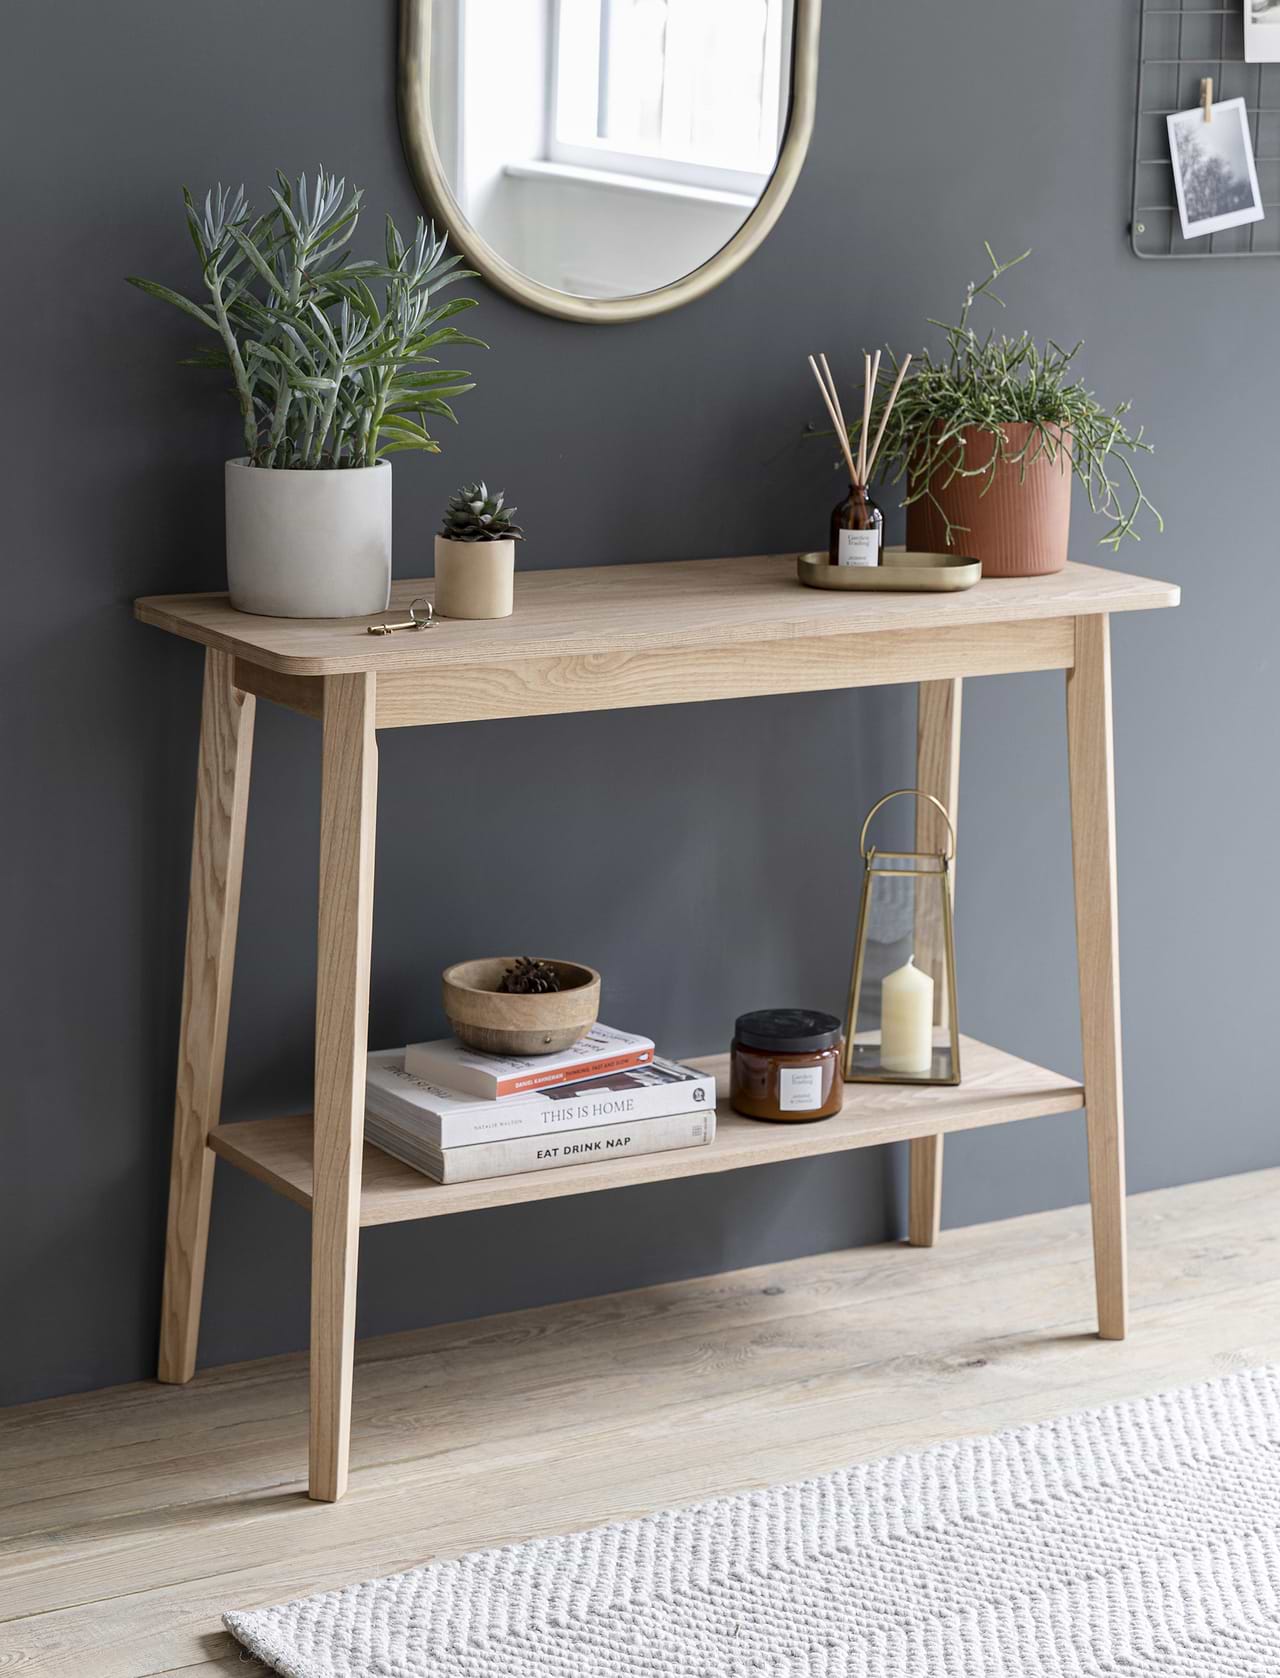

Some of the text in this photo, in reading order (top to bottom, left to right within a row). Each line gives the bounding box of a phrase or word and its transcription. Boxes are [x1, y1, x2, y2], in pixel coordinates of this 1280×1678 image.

[515, 1080, 533, 1089] DANIEL
[540, 1109, 574, 1125] THIS
[577, 1105, 589, 1120] IS
[592, 1099, 635, 1117] HOME
[536, 1136, 632, 1160] EAT DRINK NAP
